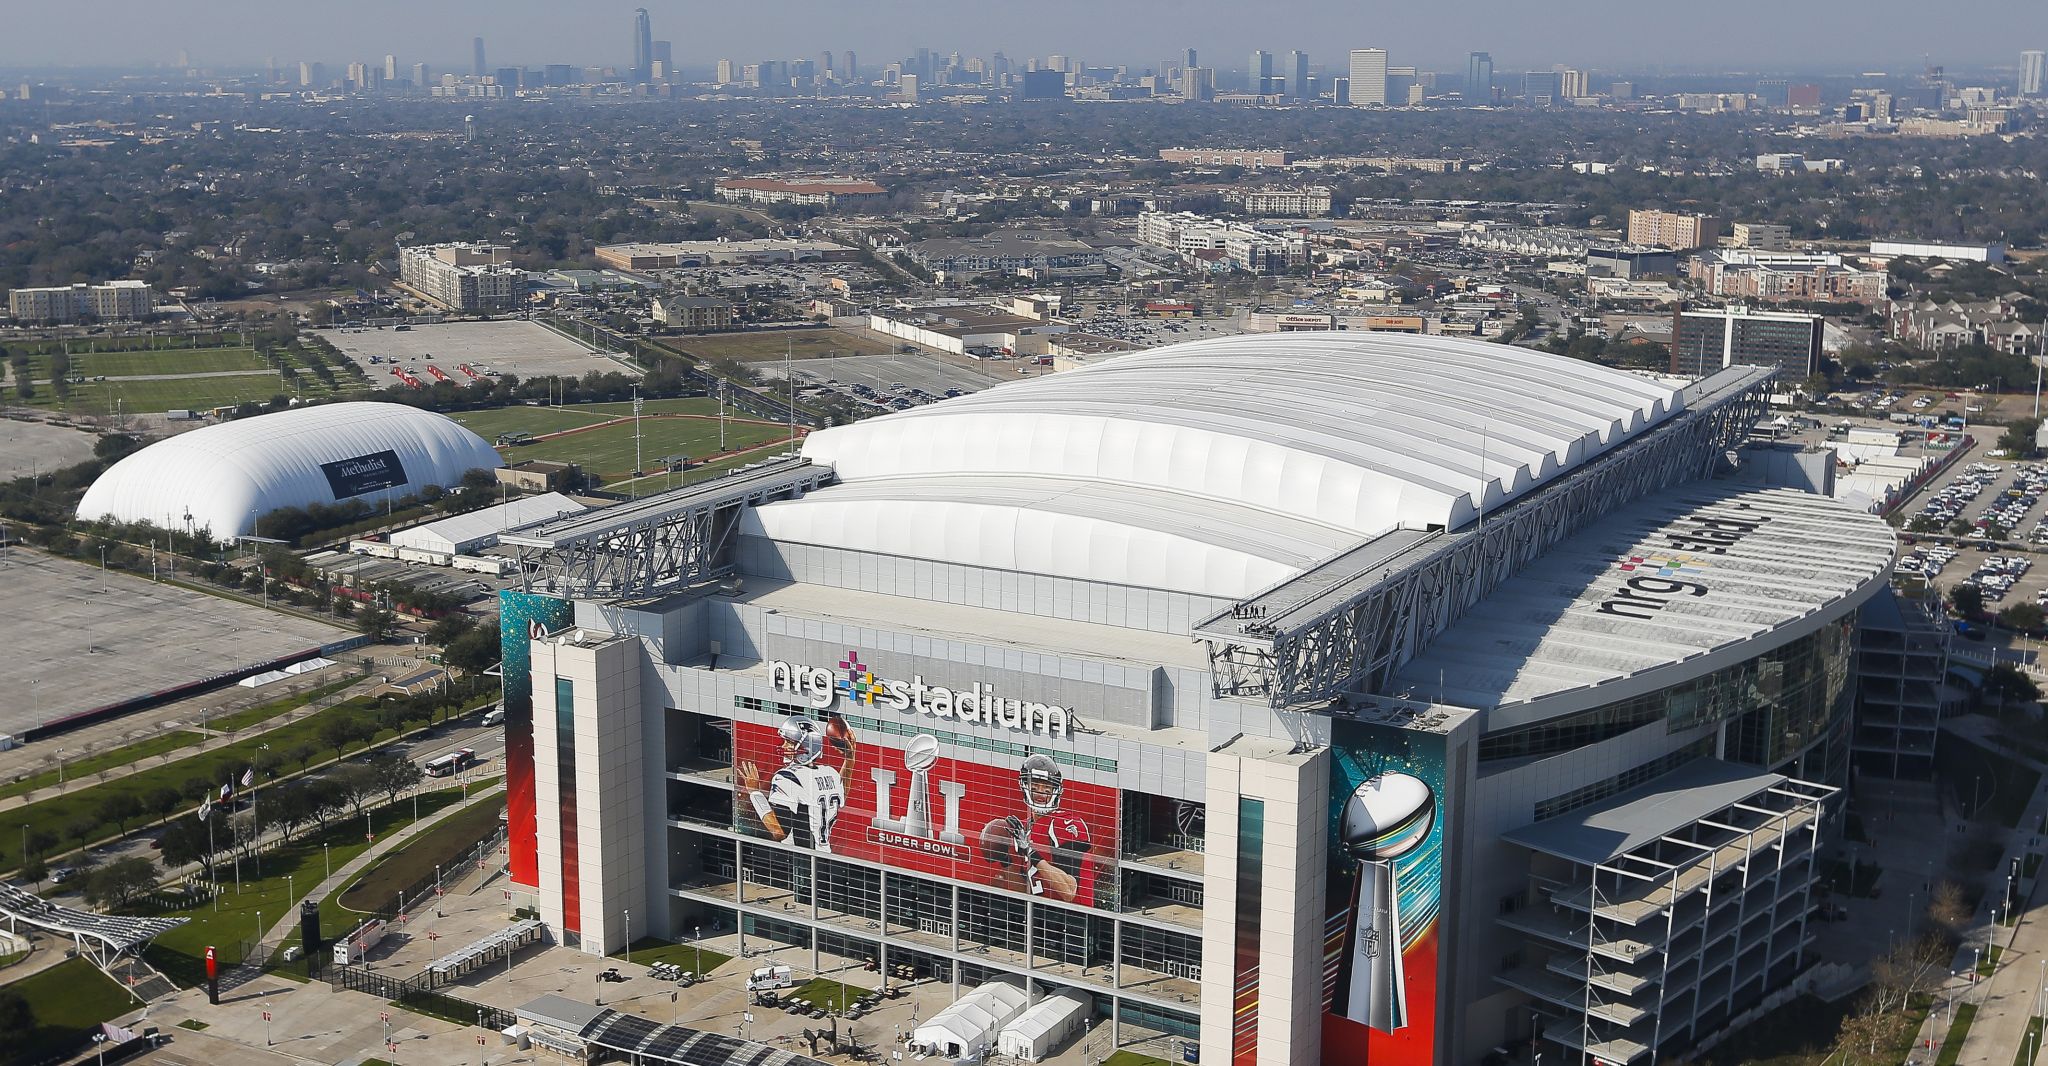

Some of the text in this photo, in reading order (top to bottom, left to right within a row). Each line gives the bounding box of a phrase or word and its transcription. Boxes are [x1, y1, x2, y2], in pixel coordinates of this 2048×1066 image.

[341, 458, 387, 478] Methodist
[1596, 576, 1709, 620] nrg
[768, 659, 1069, 738] nrg stadium
[814, 775, 836, 791] BRADY
[817, 793, 841, 846] 12
[870, 767, 966, 845] LI
[878, 832, 959, 857] SUPER BOWL
[1361, 939, 1376, 955] NFL
